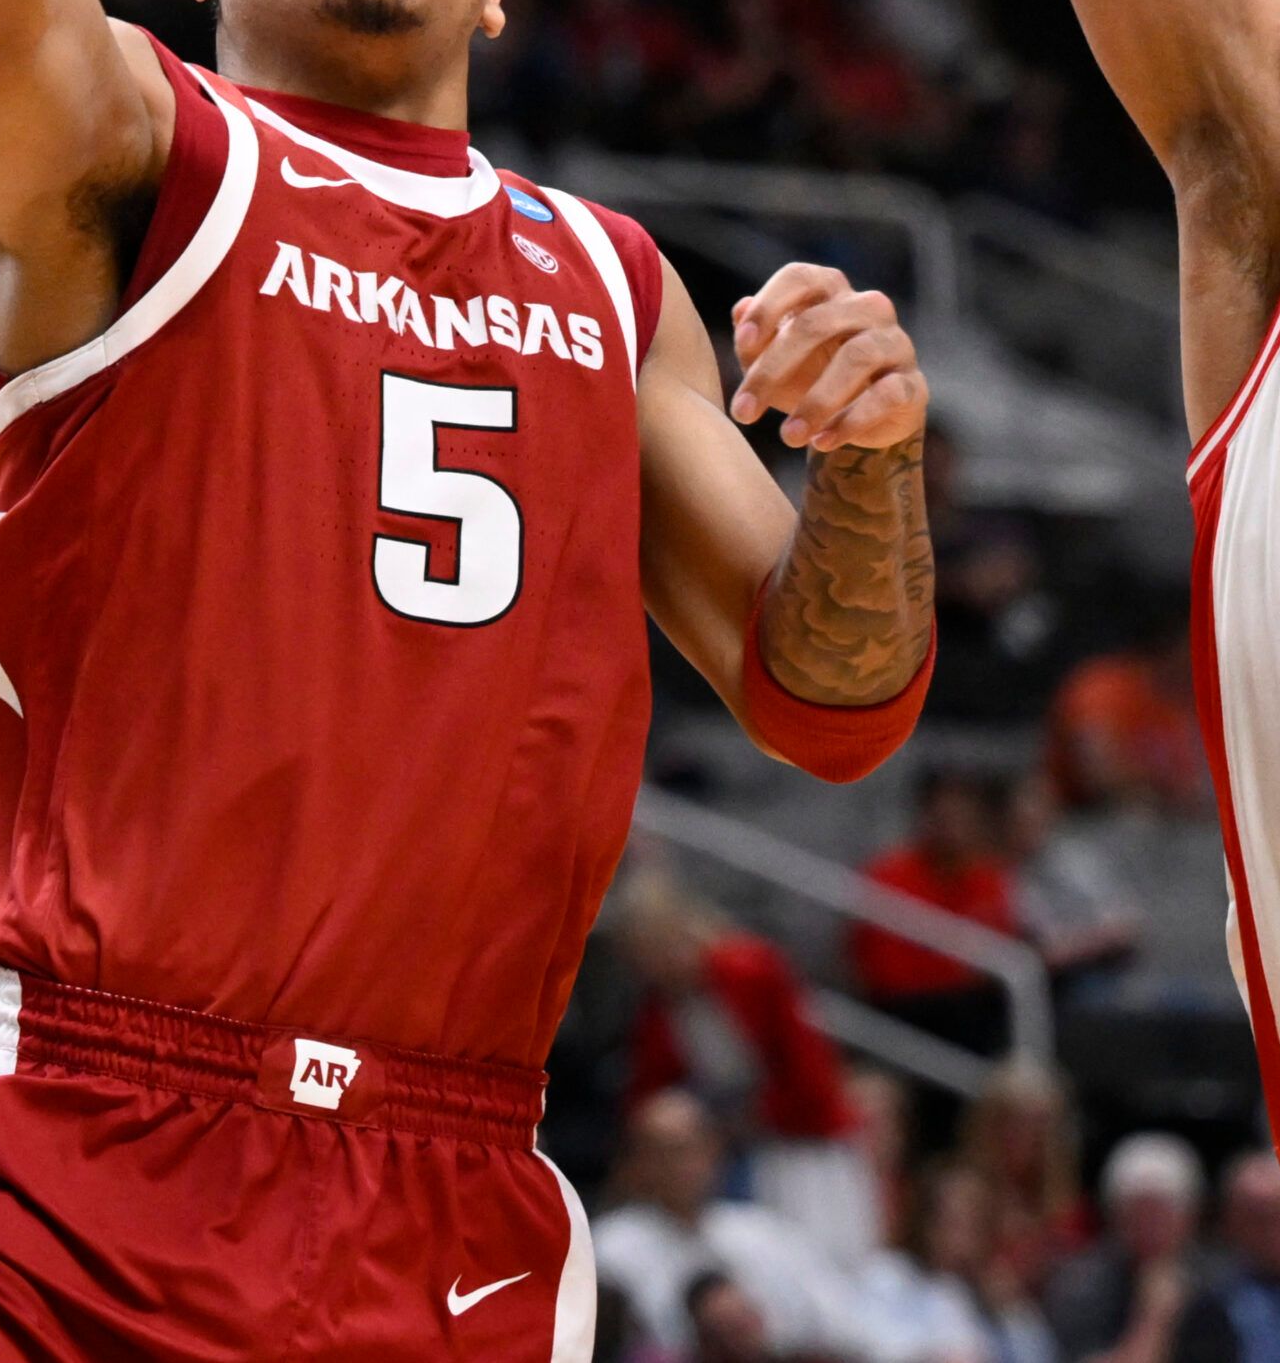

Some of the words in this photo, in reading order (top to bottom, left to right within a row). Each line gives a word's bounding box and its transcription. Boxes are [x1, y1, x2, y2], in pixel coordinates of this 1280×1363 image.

[259, 240, 605, 371] ARKANSAS
[371, 368, 525, 628] 5
[300, 1057, 348, 1091] AR
